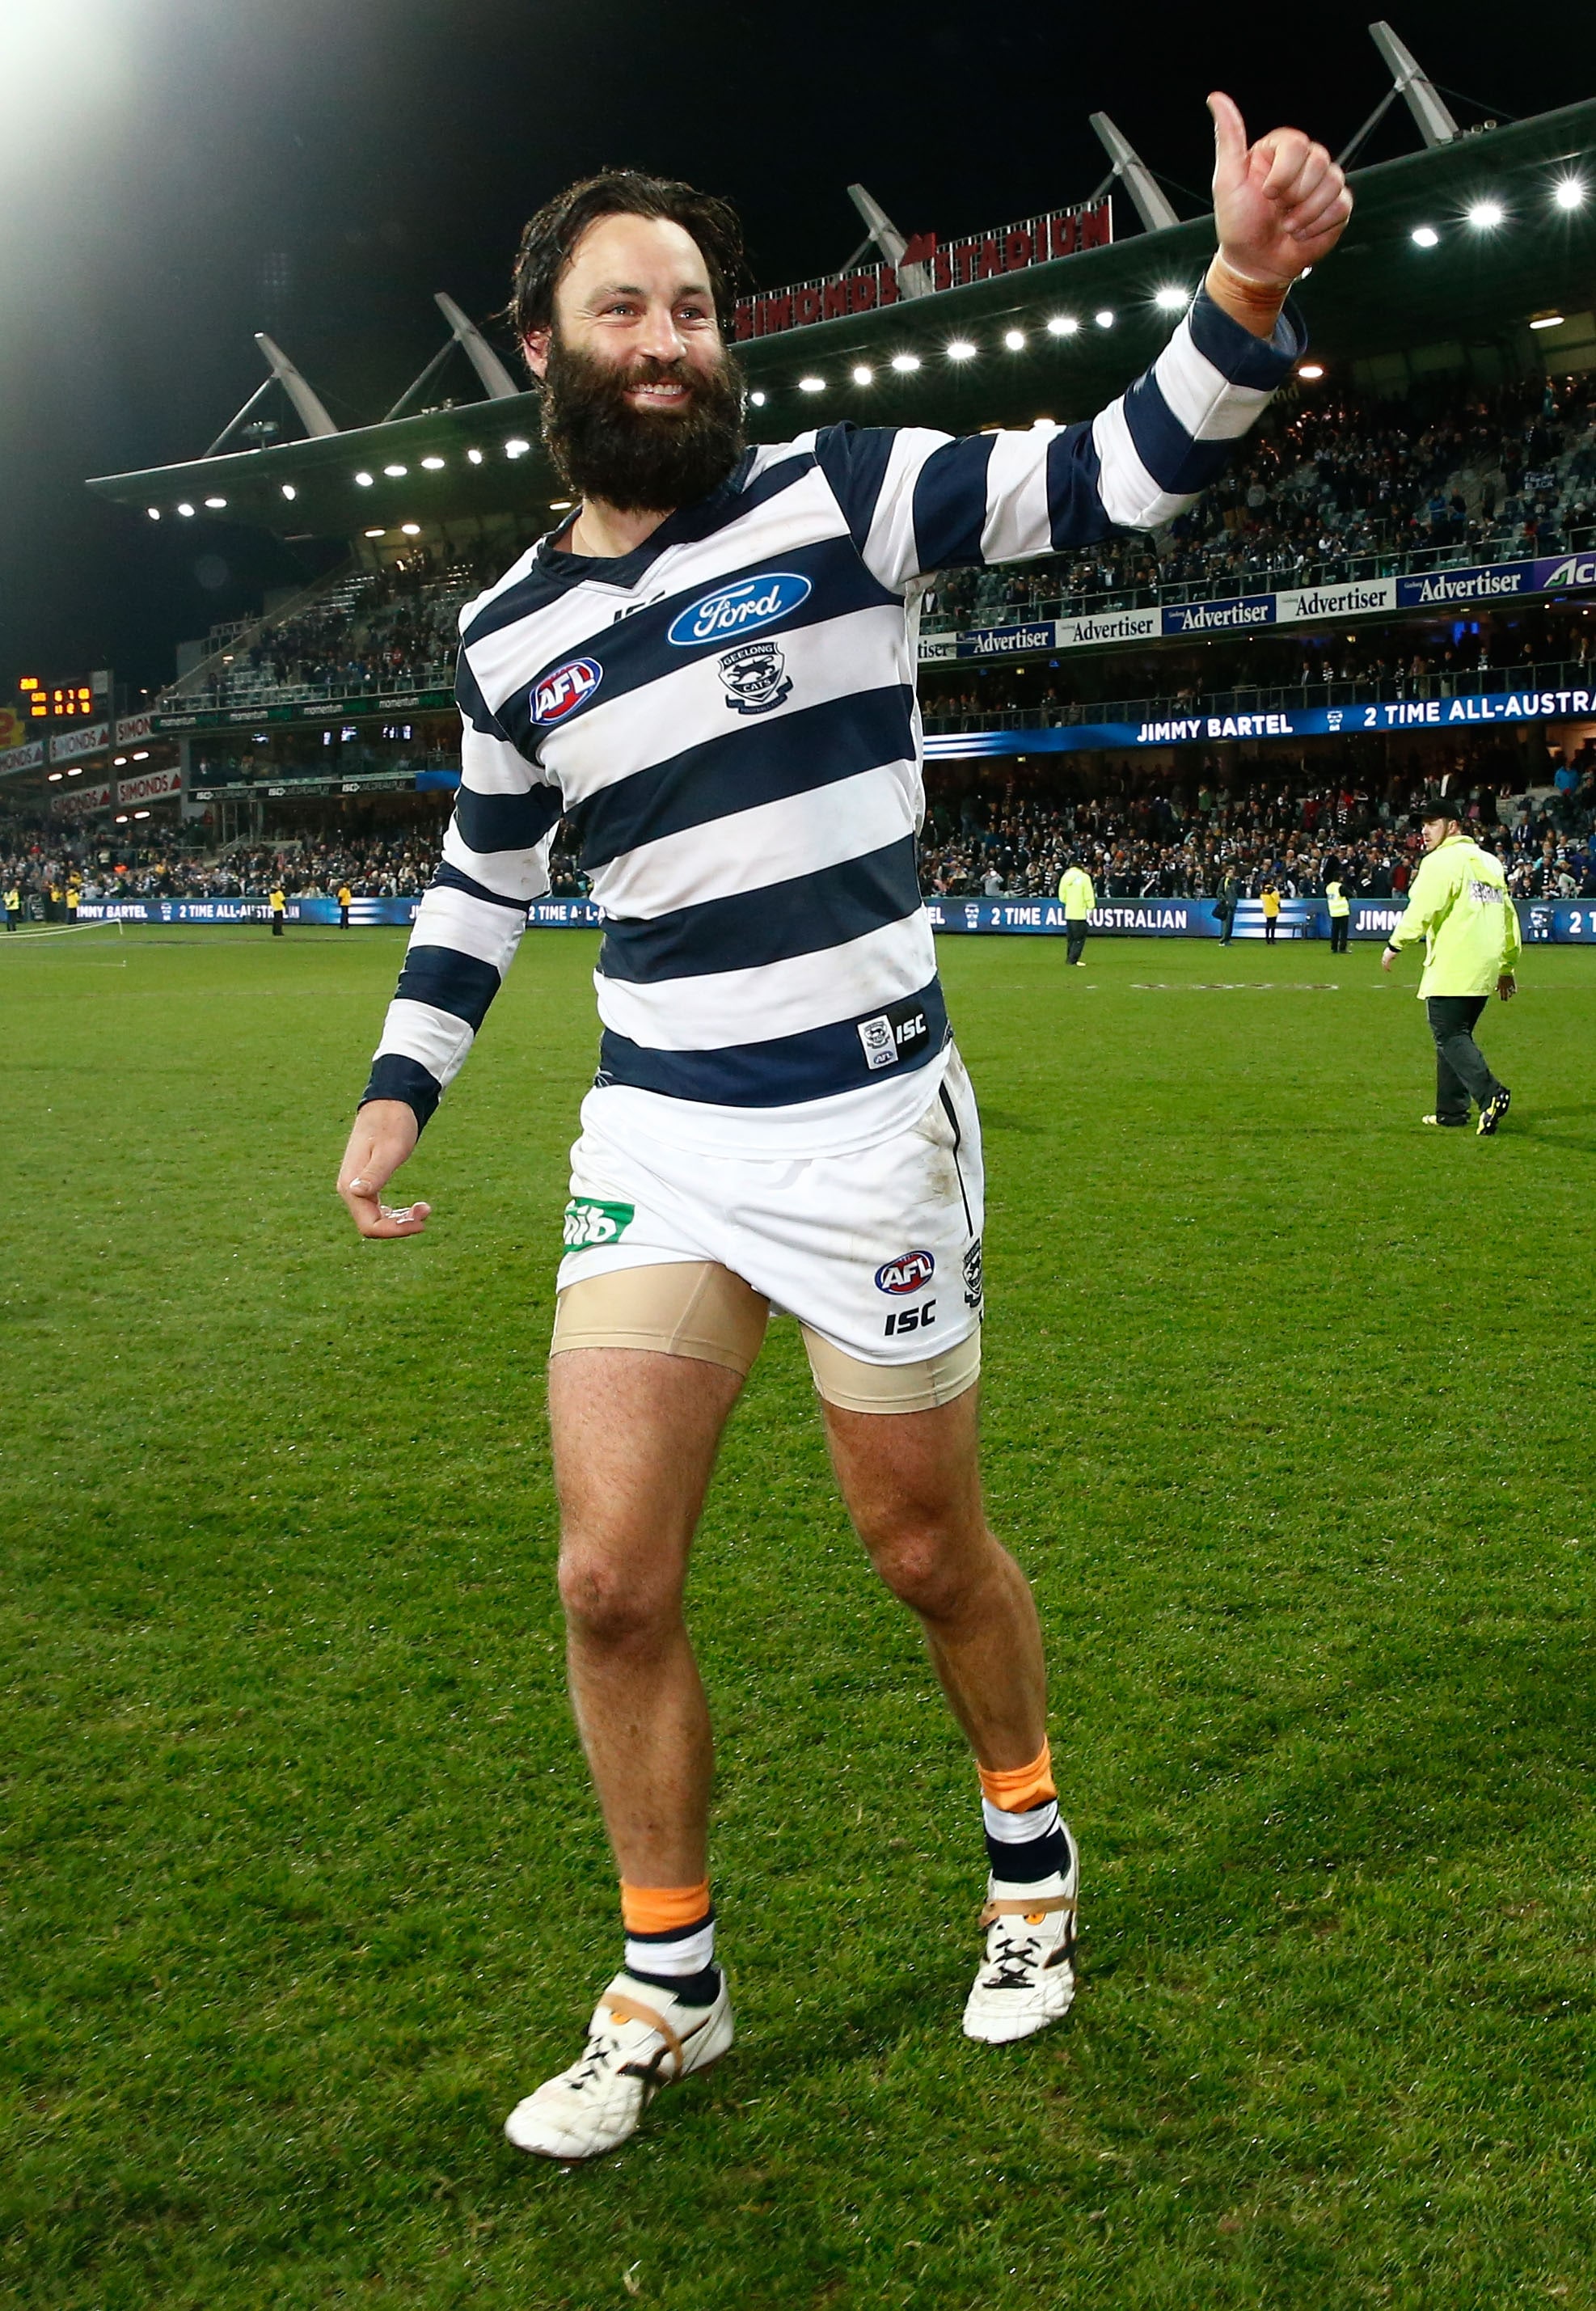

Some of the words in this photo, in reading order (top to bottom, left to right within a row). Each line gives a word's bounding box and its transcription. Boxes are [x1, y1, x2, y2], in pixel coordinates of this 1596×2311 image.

[734, 266, 901, 340] SIMONDS
[934, 205, 1109, 291] STADIUM
[1419, 570, 1521, 602] Advertiser
[693, 585, 782, 637] Ford
[1295, 587, 1387, 615] Advertiser
[1073, 616, 1154, 642] Advertiser
[1181, 602, 1269, 630] Advertiser
[723, 644, 773, 665] GEELONG
[973, 628, 1049, 653] Advertiser
[535, 665, 597, 722] AFL
[743, 678, 771, 691] CATS
[1137, 720, 1201, 742] JIMMY
[1207, 714, 1294, 737] BARTEL
[1364, 708, 1377, 727] 2
[1385, 702, 1441, 725] TIME
[52, 730, 96, 757] SONDS
[120, 774, 168, 802] SIMONDS
[106, 905, 148, 919] BARTEL
[179, 905, 187, 919] 2
[188, 905, 213, 919] TIME
[538, 906, 567, 920] TIME
[990, 907, 1001, 925] 2
[1004, 907, 1041, 926] TIME
[1569, 910, 1582, 934] 2
[896, 1013, 927, 1044] ISC
[881, 1257, 933, 1289] AFL
[885, 1299, 936, 1336] ISC
